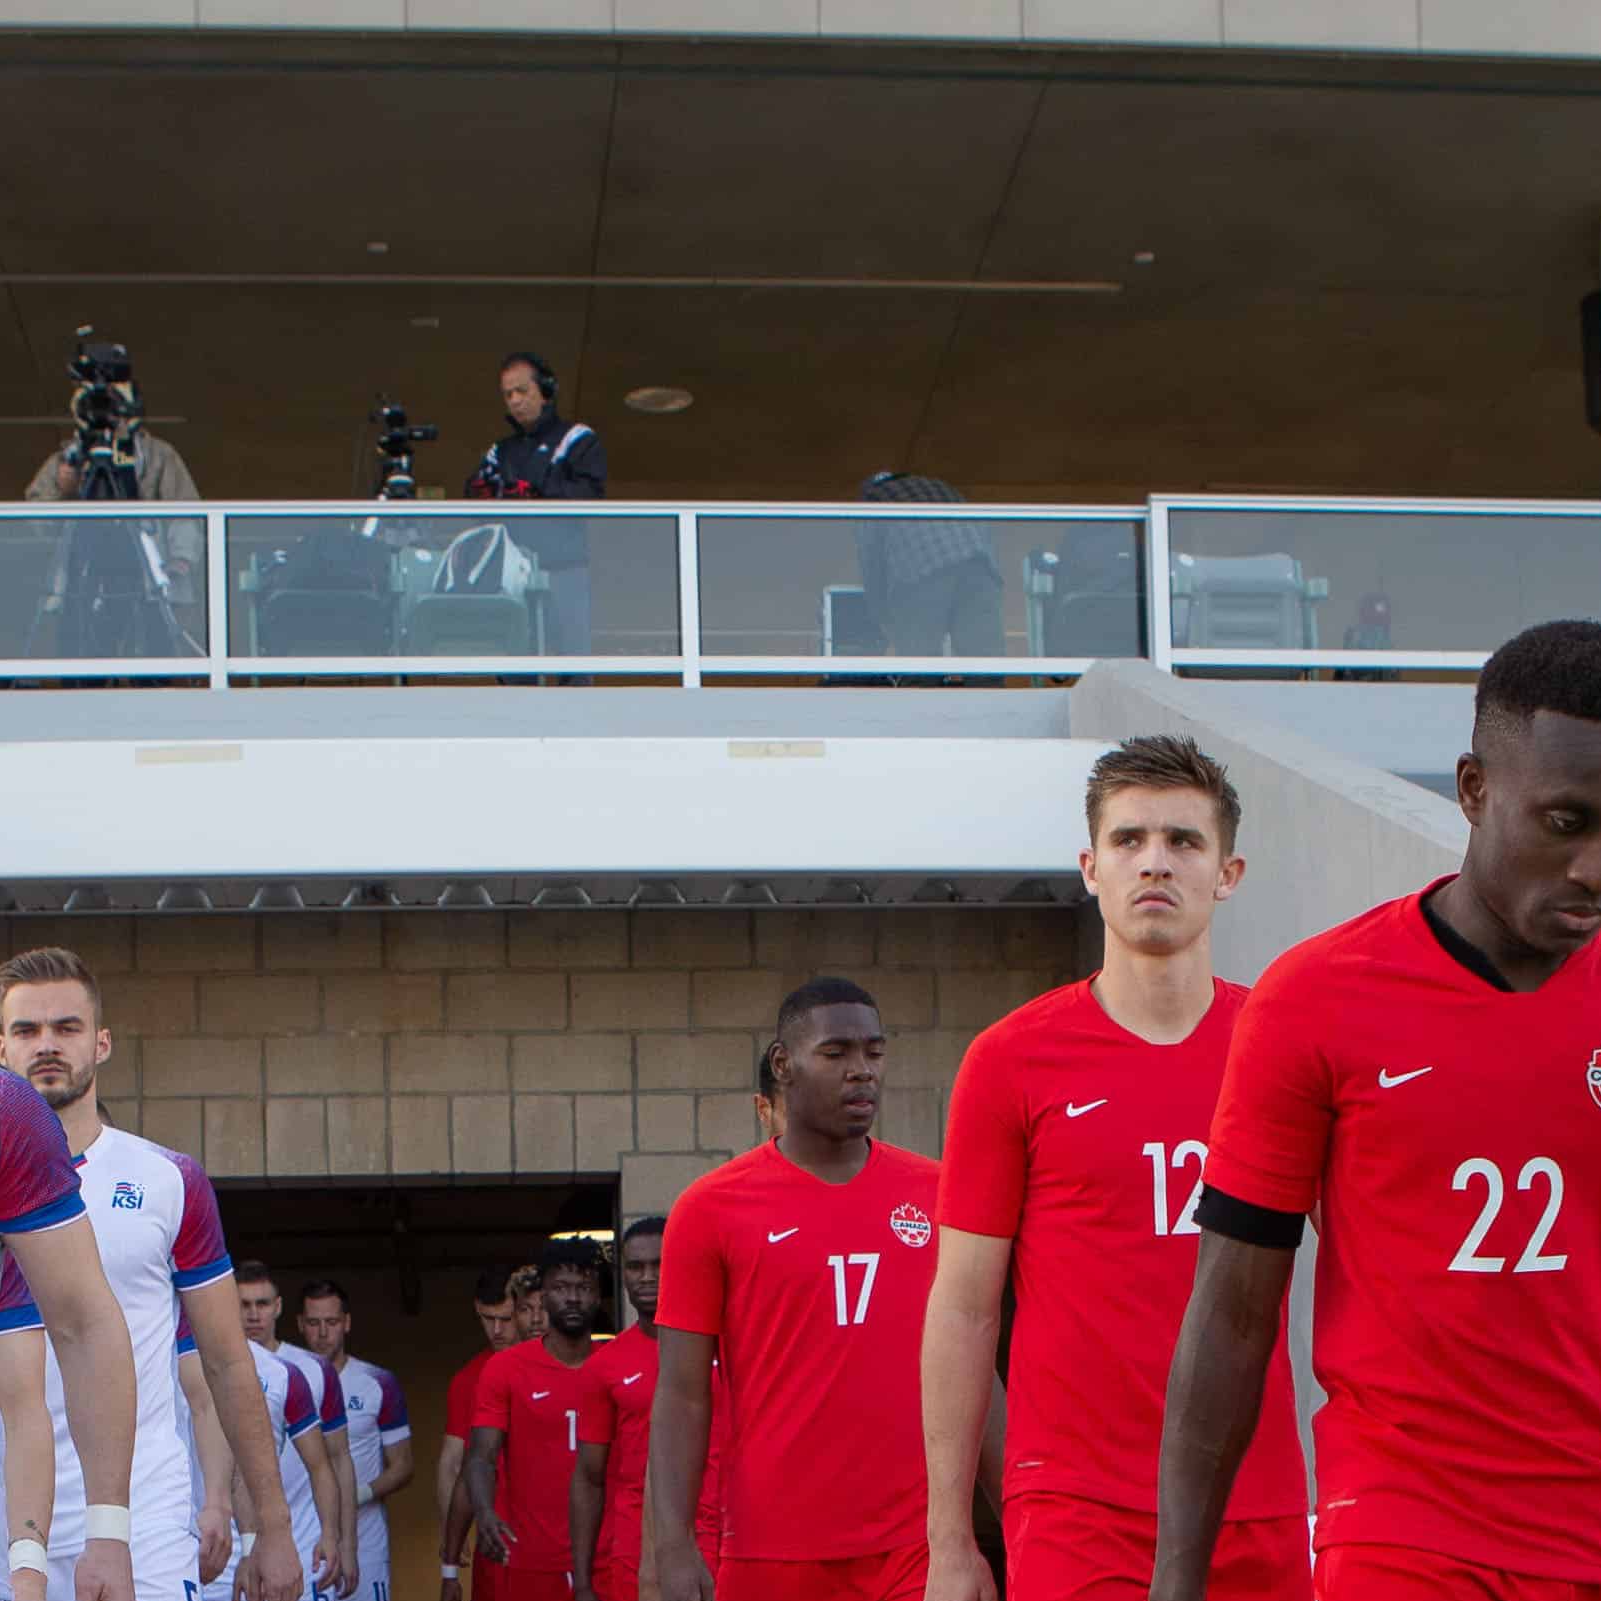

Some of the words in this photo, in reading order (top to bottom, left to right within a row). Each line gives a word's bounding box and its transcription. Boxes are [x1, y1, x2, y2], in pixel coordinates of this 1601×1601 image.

[1142, 1140, 1209, 1237] 12
[1447, 1156, 1569, 1274] 22
[892, 1219, 930, 1233] CANADA
[826, 1252, 881, 1326] 17
[565, 1409, 577, 1452] 1
